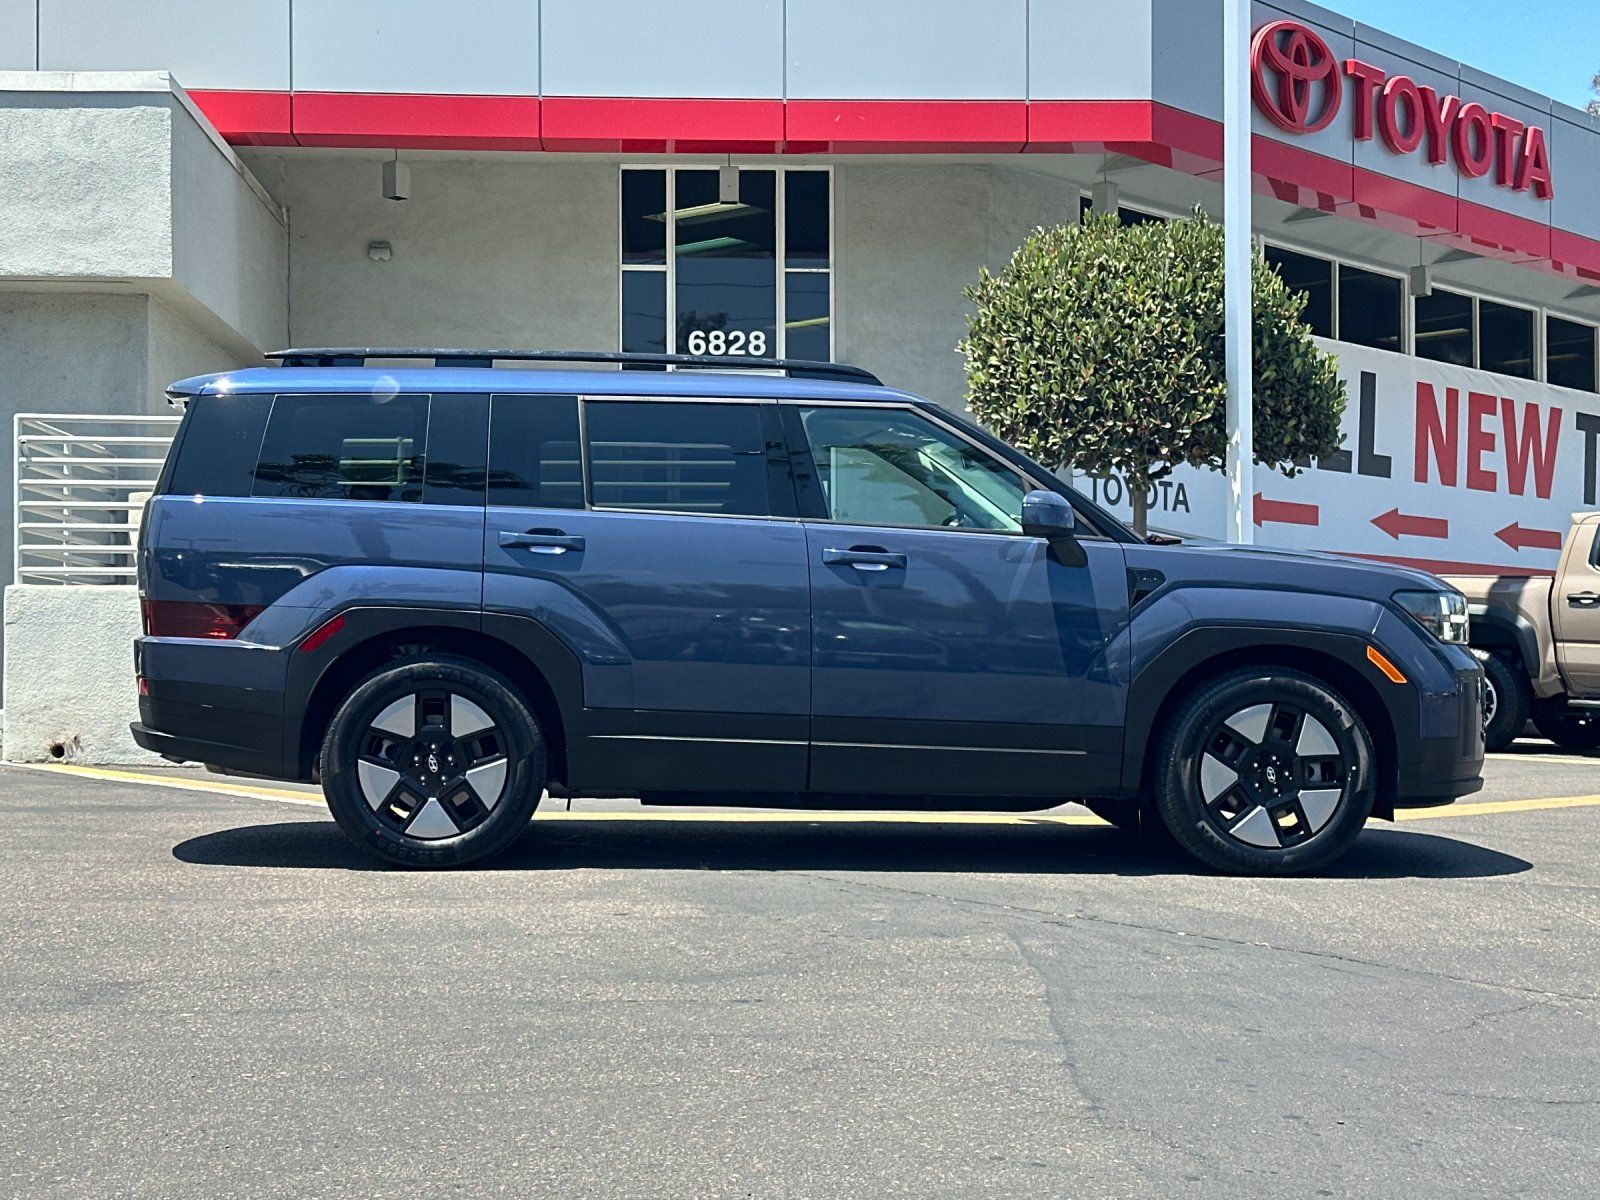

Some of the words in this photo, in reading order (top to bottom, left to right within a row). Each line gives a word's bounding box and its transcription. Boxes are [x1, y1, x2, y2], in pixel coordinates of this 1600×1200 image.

[1343, 58, 1554, 200] TOYOTA
[688, 330, 767, 356] 6828
[1414, 381, 1563, 500] NEW
